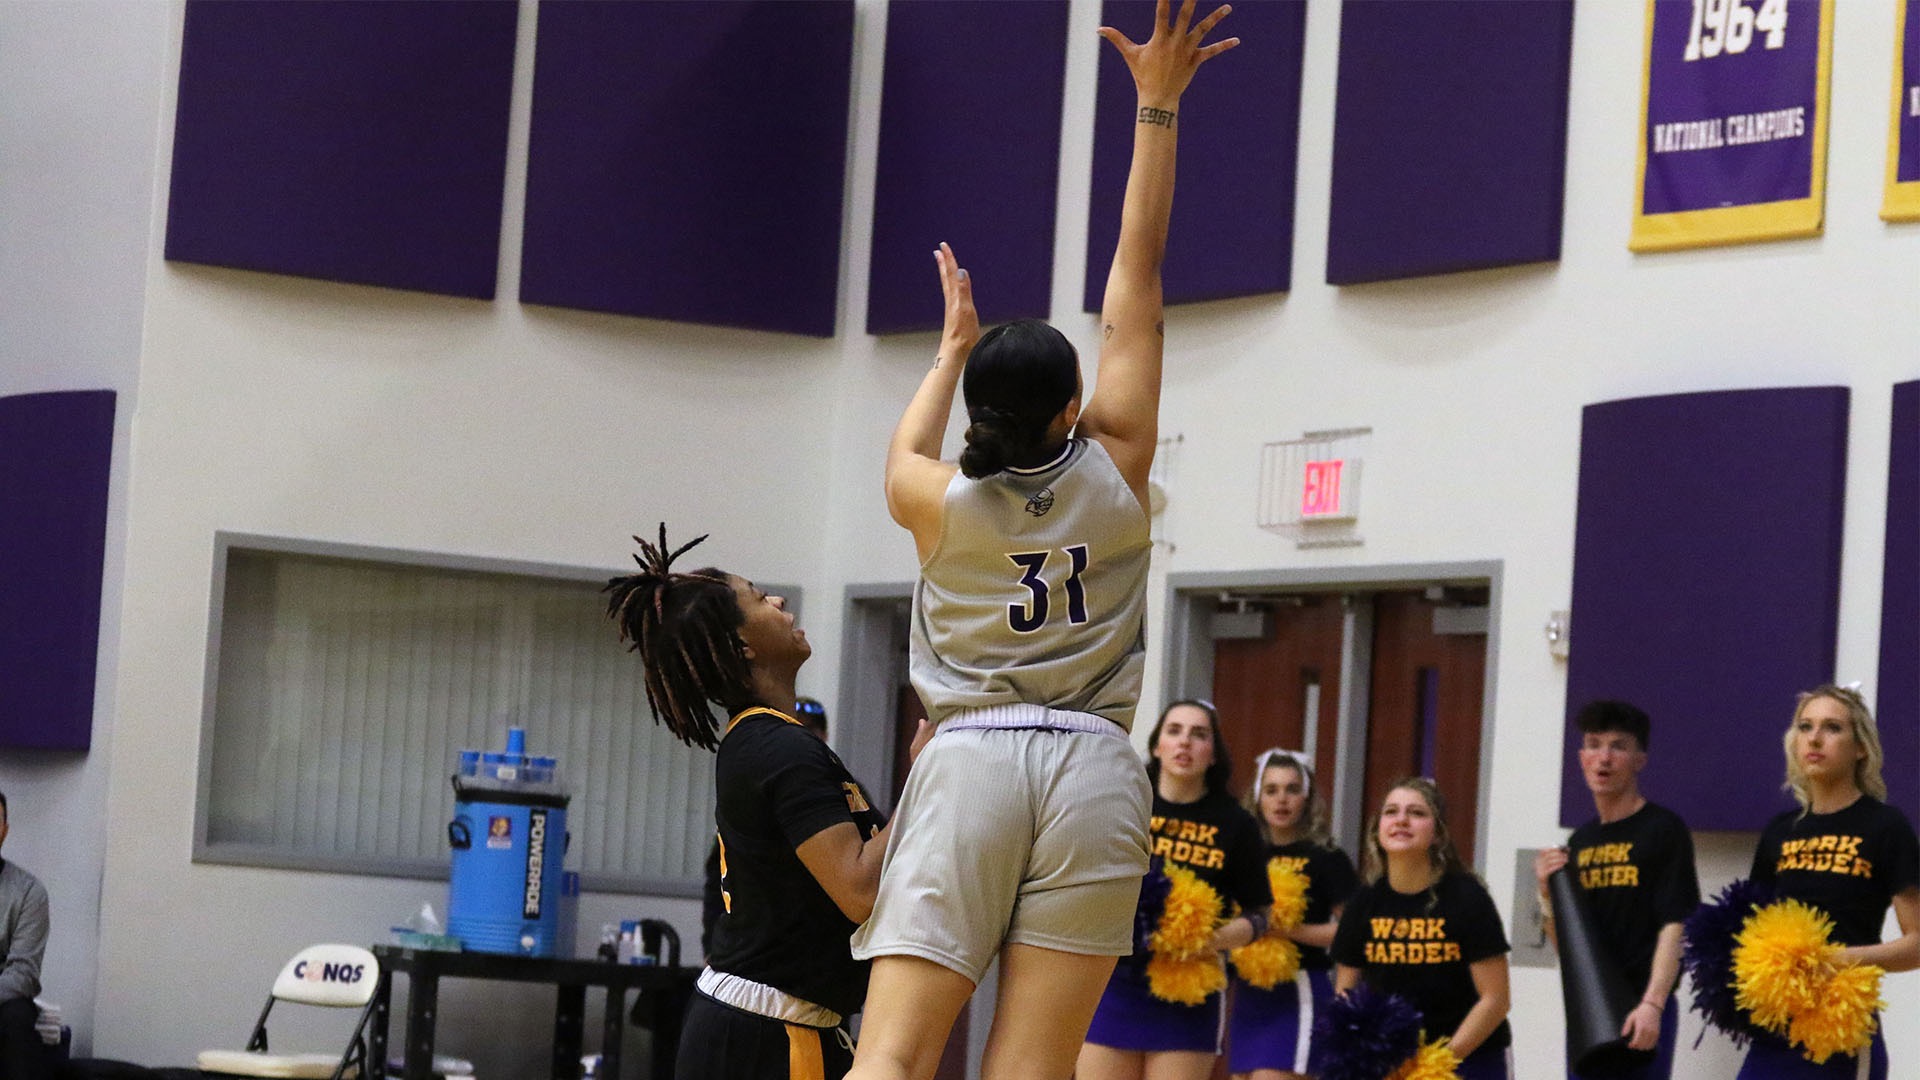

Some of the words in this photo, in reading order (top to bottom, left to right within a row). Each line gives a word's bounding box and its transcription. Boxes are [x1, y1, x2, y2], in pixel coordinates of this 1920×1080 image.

[1683, 0, 1788, 61] 1964
[1654, 118, 1724, 153] NATIONAL
[1726, 106, 1805, 146] CHAMPIONS
[1303, 460, 1343, 514] EXIT
[1006, 542, 1091, 634] 31
[525, 814, 546, 914] POWERADE
[1781, 834, 1864, 856] WORK
[1370, 917, 1446, 940] WORK
